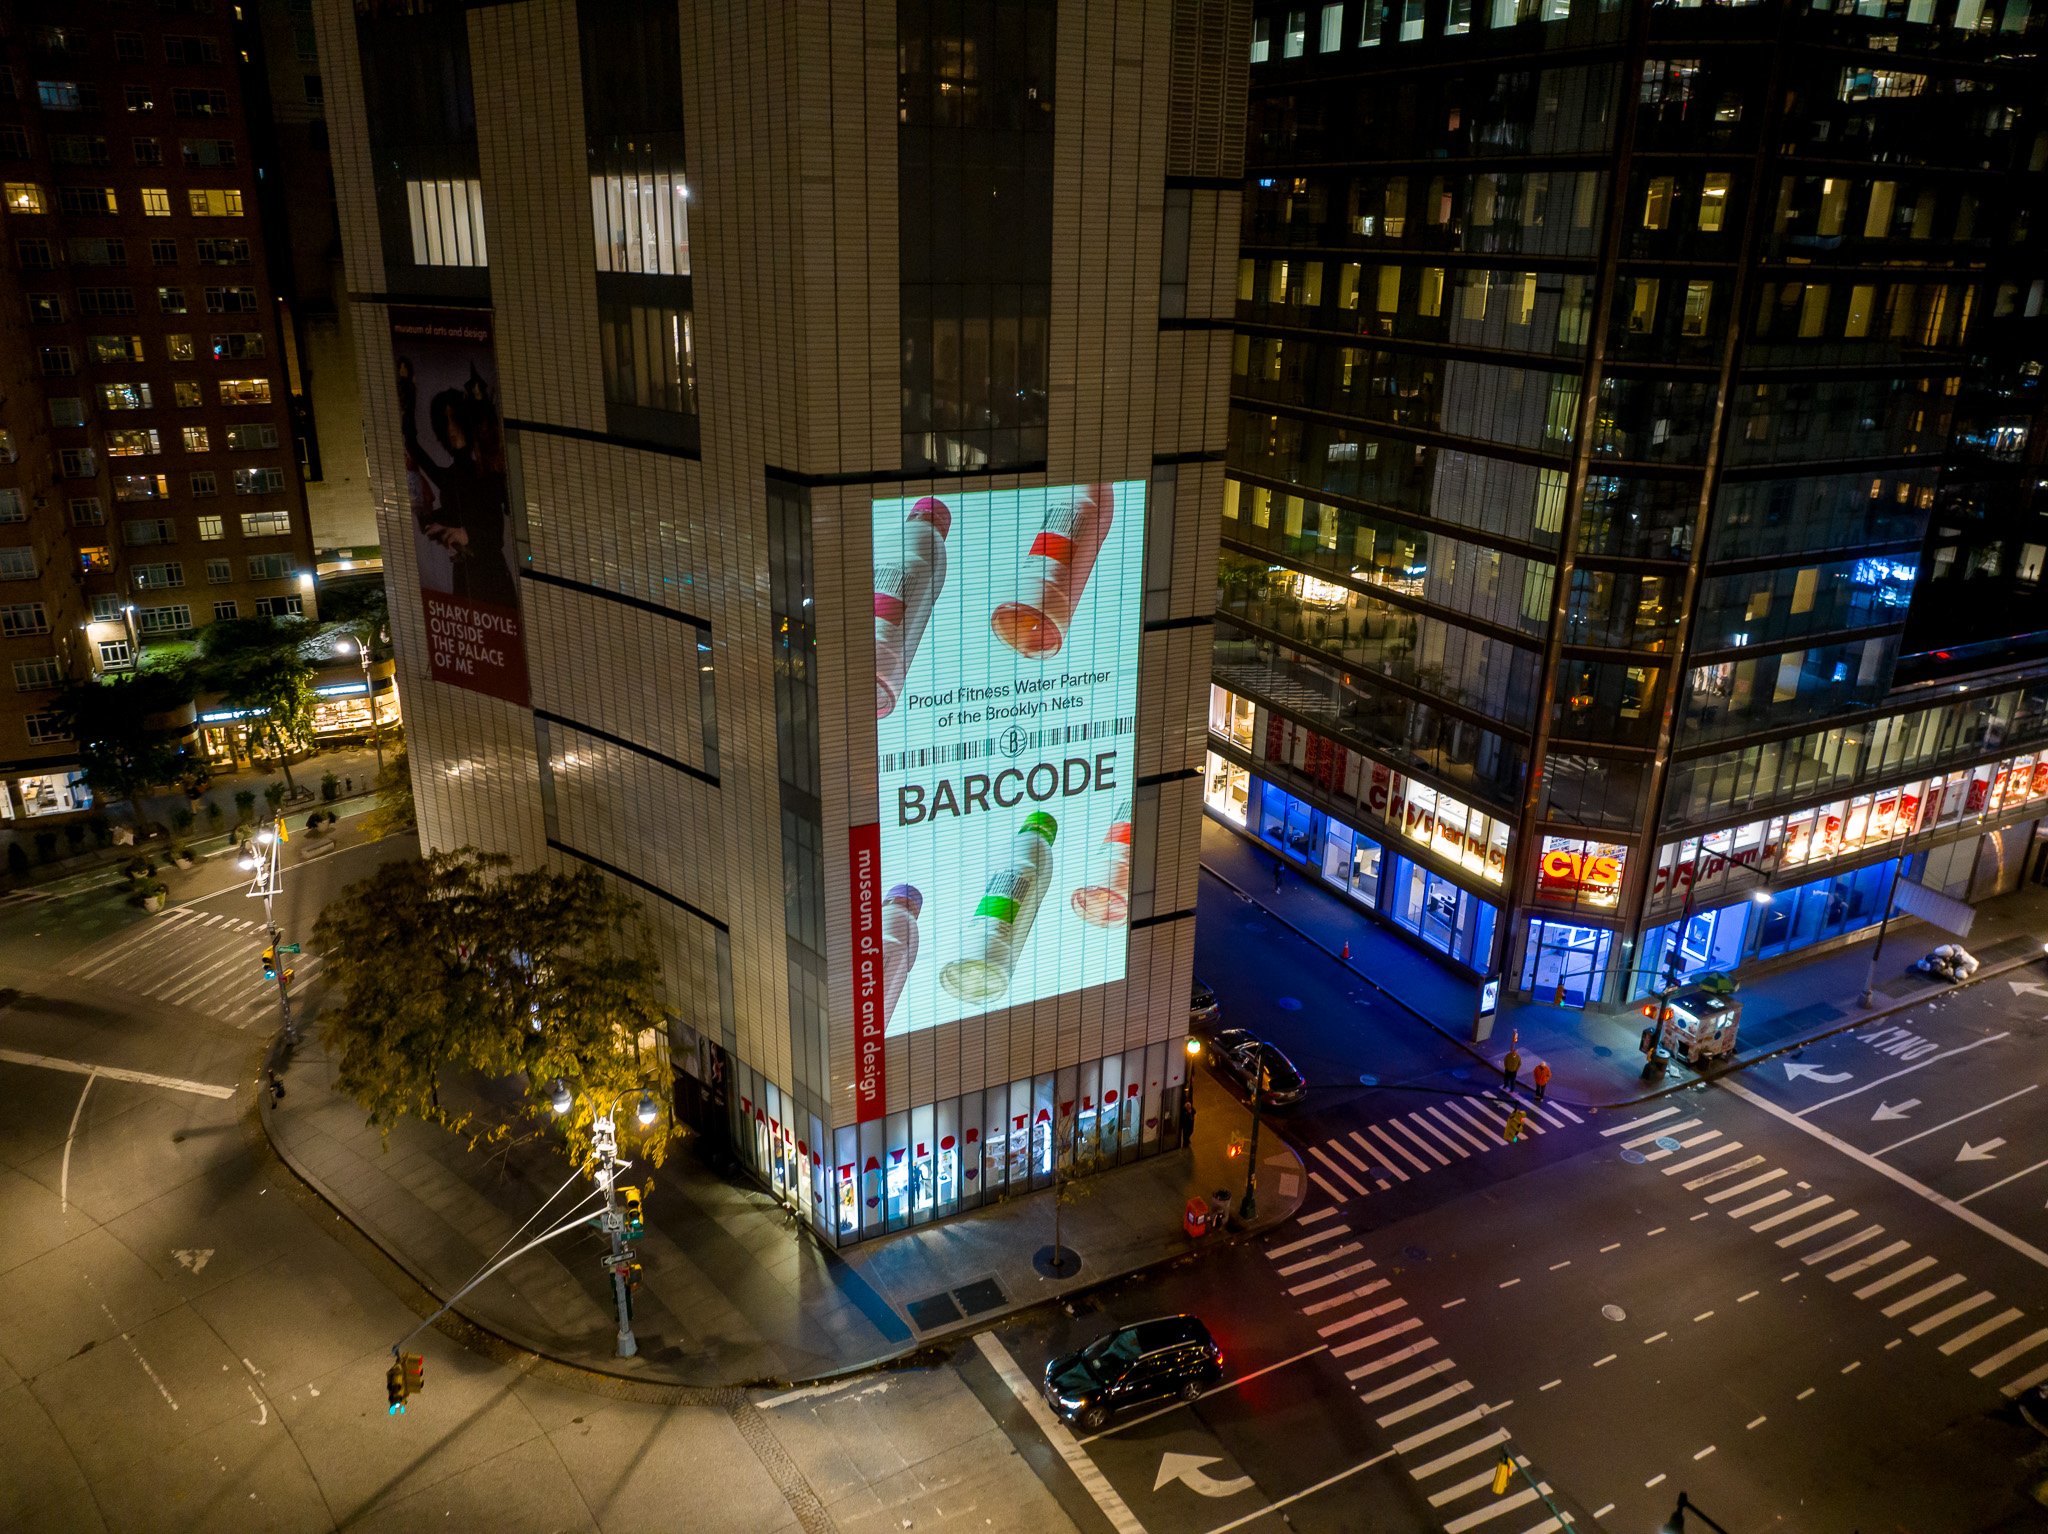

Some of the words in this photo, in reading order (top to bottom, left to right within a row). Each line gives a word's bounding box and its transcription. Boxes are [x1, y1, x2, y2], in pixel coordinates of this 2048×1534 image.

[428, 600, 470, 624] SHARY
[472, 610, 518, 636] BOYLE:
[430, 617, 485, 645] OUTSIDE
[431, 634, 456, 654] THE
[457, 640, 505, 667] PALACE
[434, 651, 452, 670] OF
[455, 657, 475, 675] ME
[908, 687, 953, 710] Proud
[957, 683, 1010, 703] Fitness
[1013, 677, 1057, 695] Water
[1060, 671, 1111, 692] Partner
[937, 712, 954, 728] of
[957, 708, 982, 725] the
[985, 700, 1048, 721] Brooklyn
[1051, 694, 1084, 712] Nets
[898, 751, 1118, 828] BARCODE
[1543, 850, 1620, 885] CVS
[858, 848, 872, 932] museum
[860, 936, 880, 956] of
[860, 960, 877, 998] arts
[862, 1001, 881, 1037] and
[1856, 1025, 1940, 1061] ONLY
[859, 1042, 882, 1102] design
[1012, 1082, 1140, 1130] TAYLOR
[740, 1095, 821, 1170] TAYLOR
[837, 1127, 980, 1183] TAYLOR
